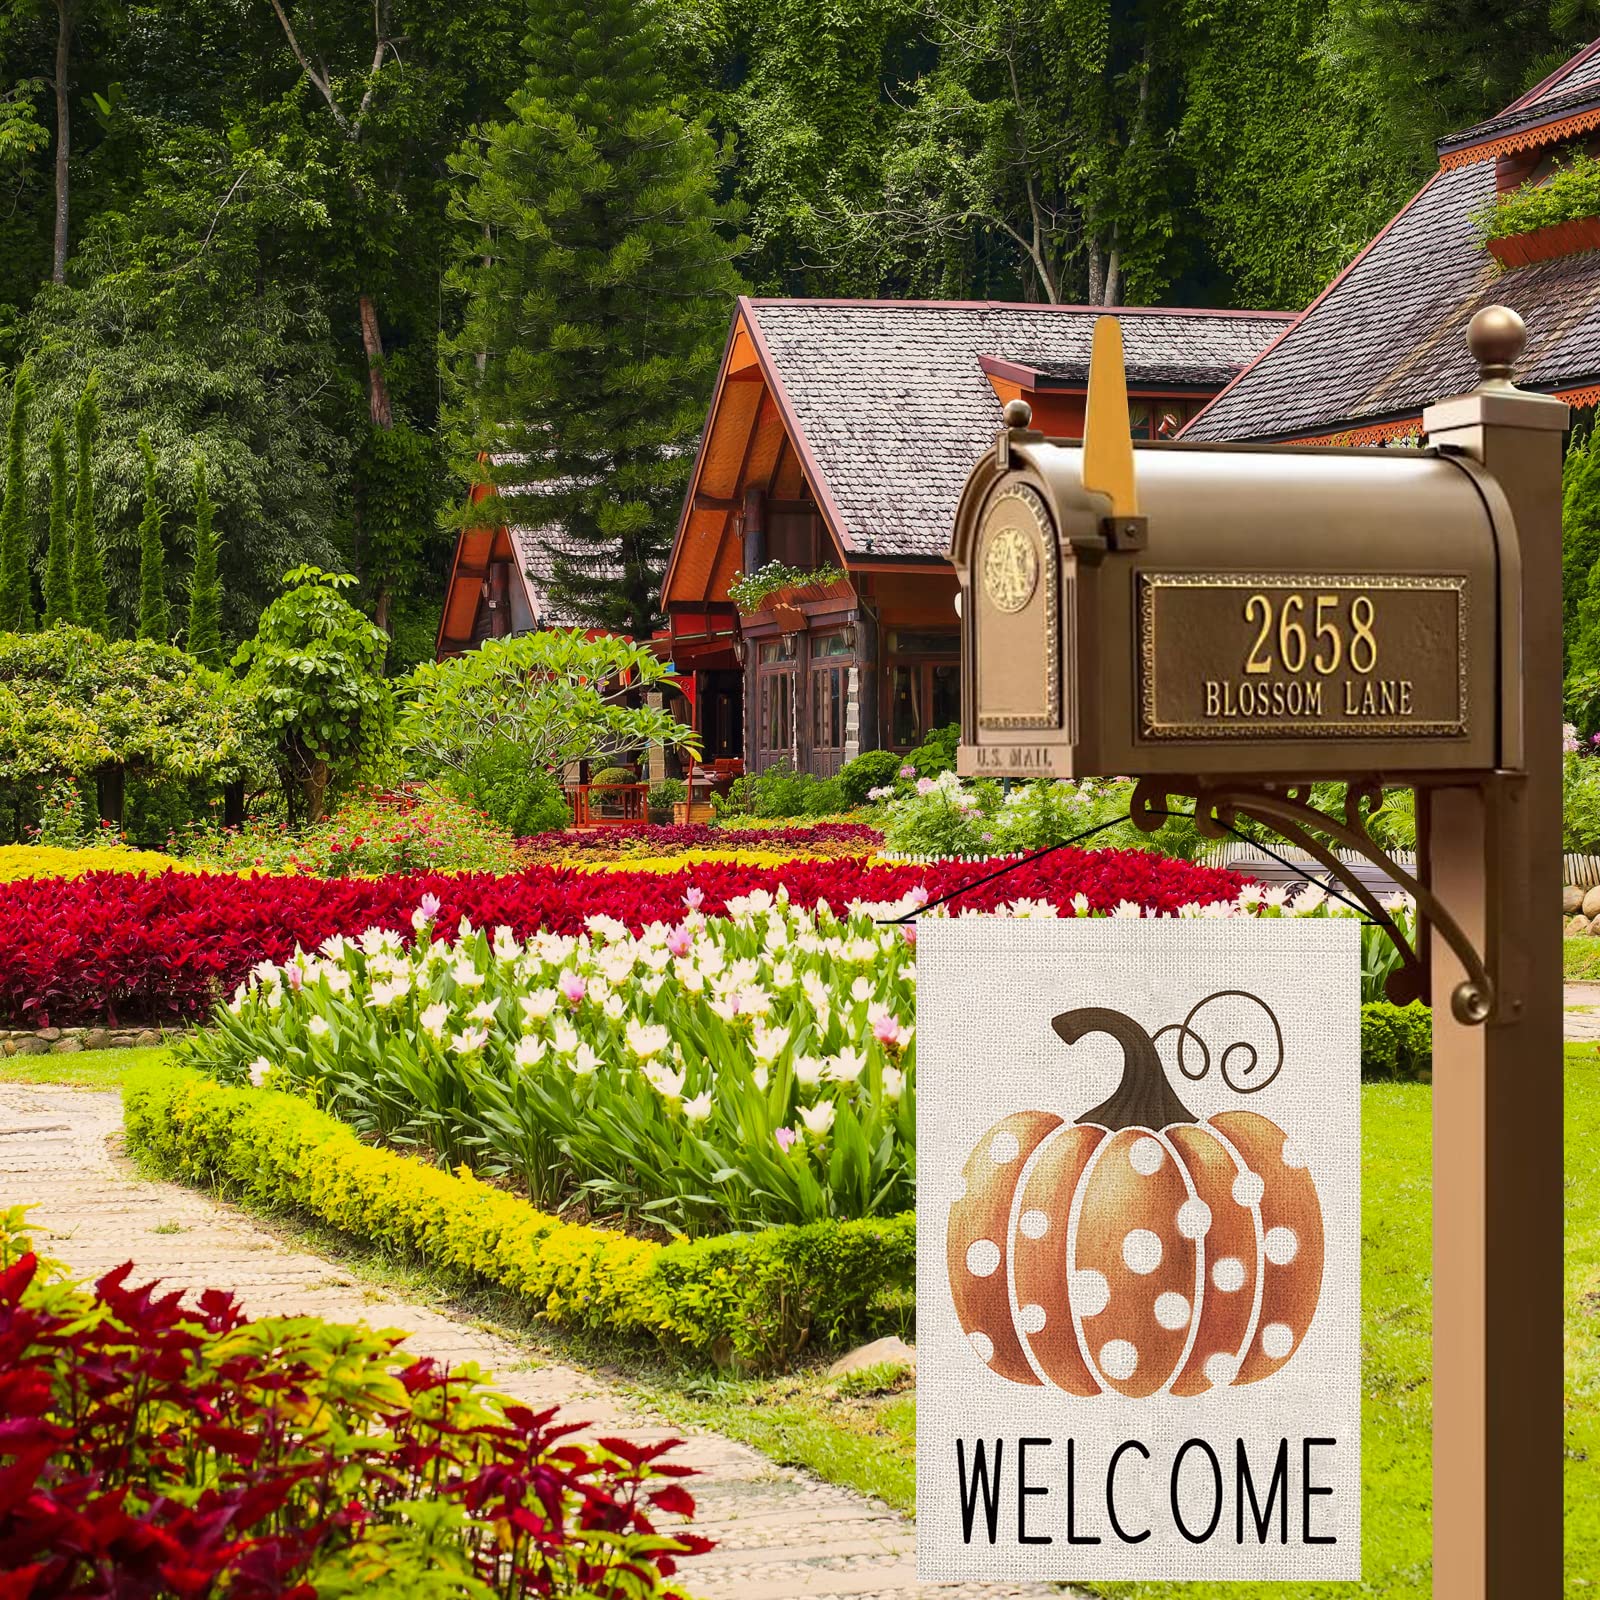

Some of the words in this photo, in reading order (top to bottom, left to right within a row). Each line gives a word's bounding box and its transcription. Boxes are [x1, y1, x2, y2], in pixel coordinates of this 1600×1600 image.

[1245, 594, 1377, 674] 2658
[1206, 680, 1323, 716] BLOSSOM
[1345, 680, 1414, 716] LANE
[977, 748, 1002, 767] U.S.
[1009, 748, 1053, 767] MAIL
[956, 1437, 1337, 1544] WELCOME
